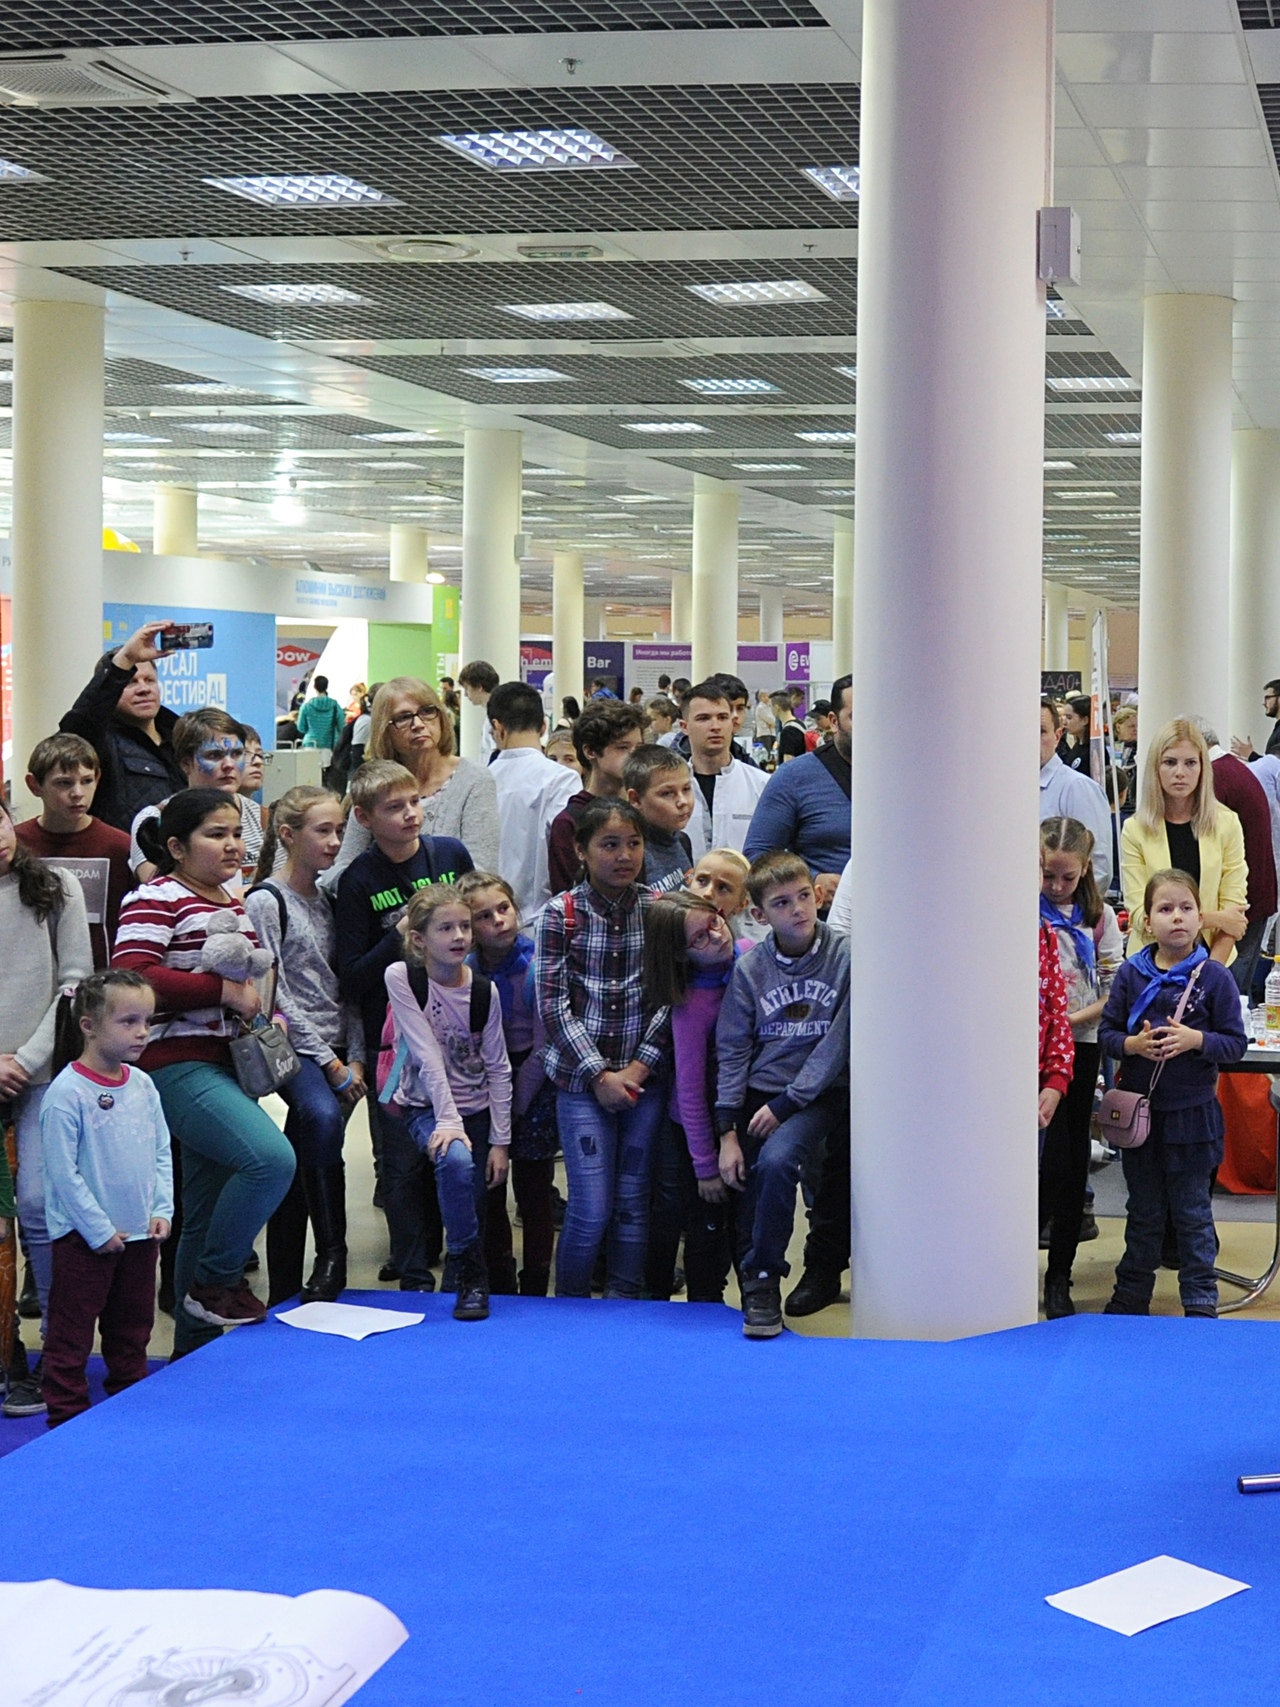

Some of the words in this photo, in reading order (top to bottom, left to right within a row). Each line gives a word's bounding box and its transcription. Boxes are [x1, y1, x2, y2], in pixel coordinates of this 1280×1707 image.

[587, 656, 611, 668] Bar
[649, 867, 685, 895] HAMPION
[760, 979, 838, 1017] ATHLETIC
